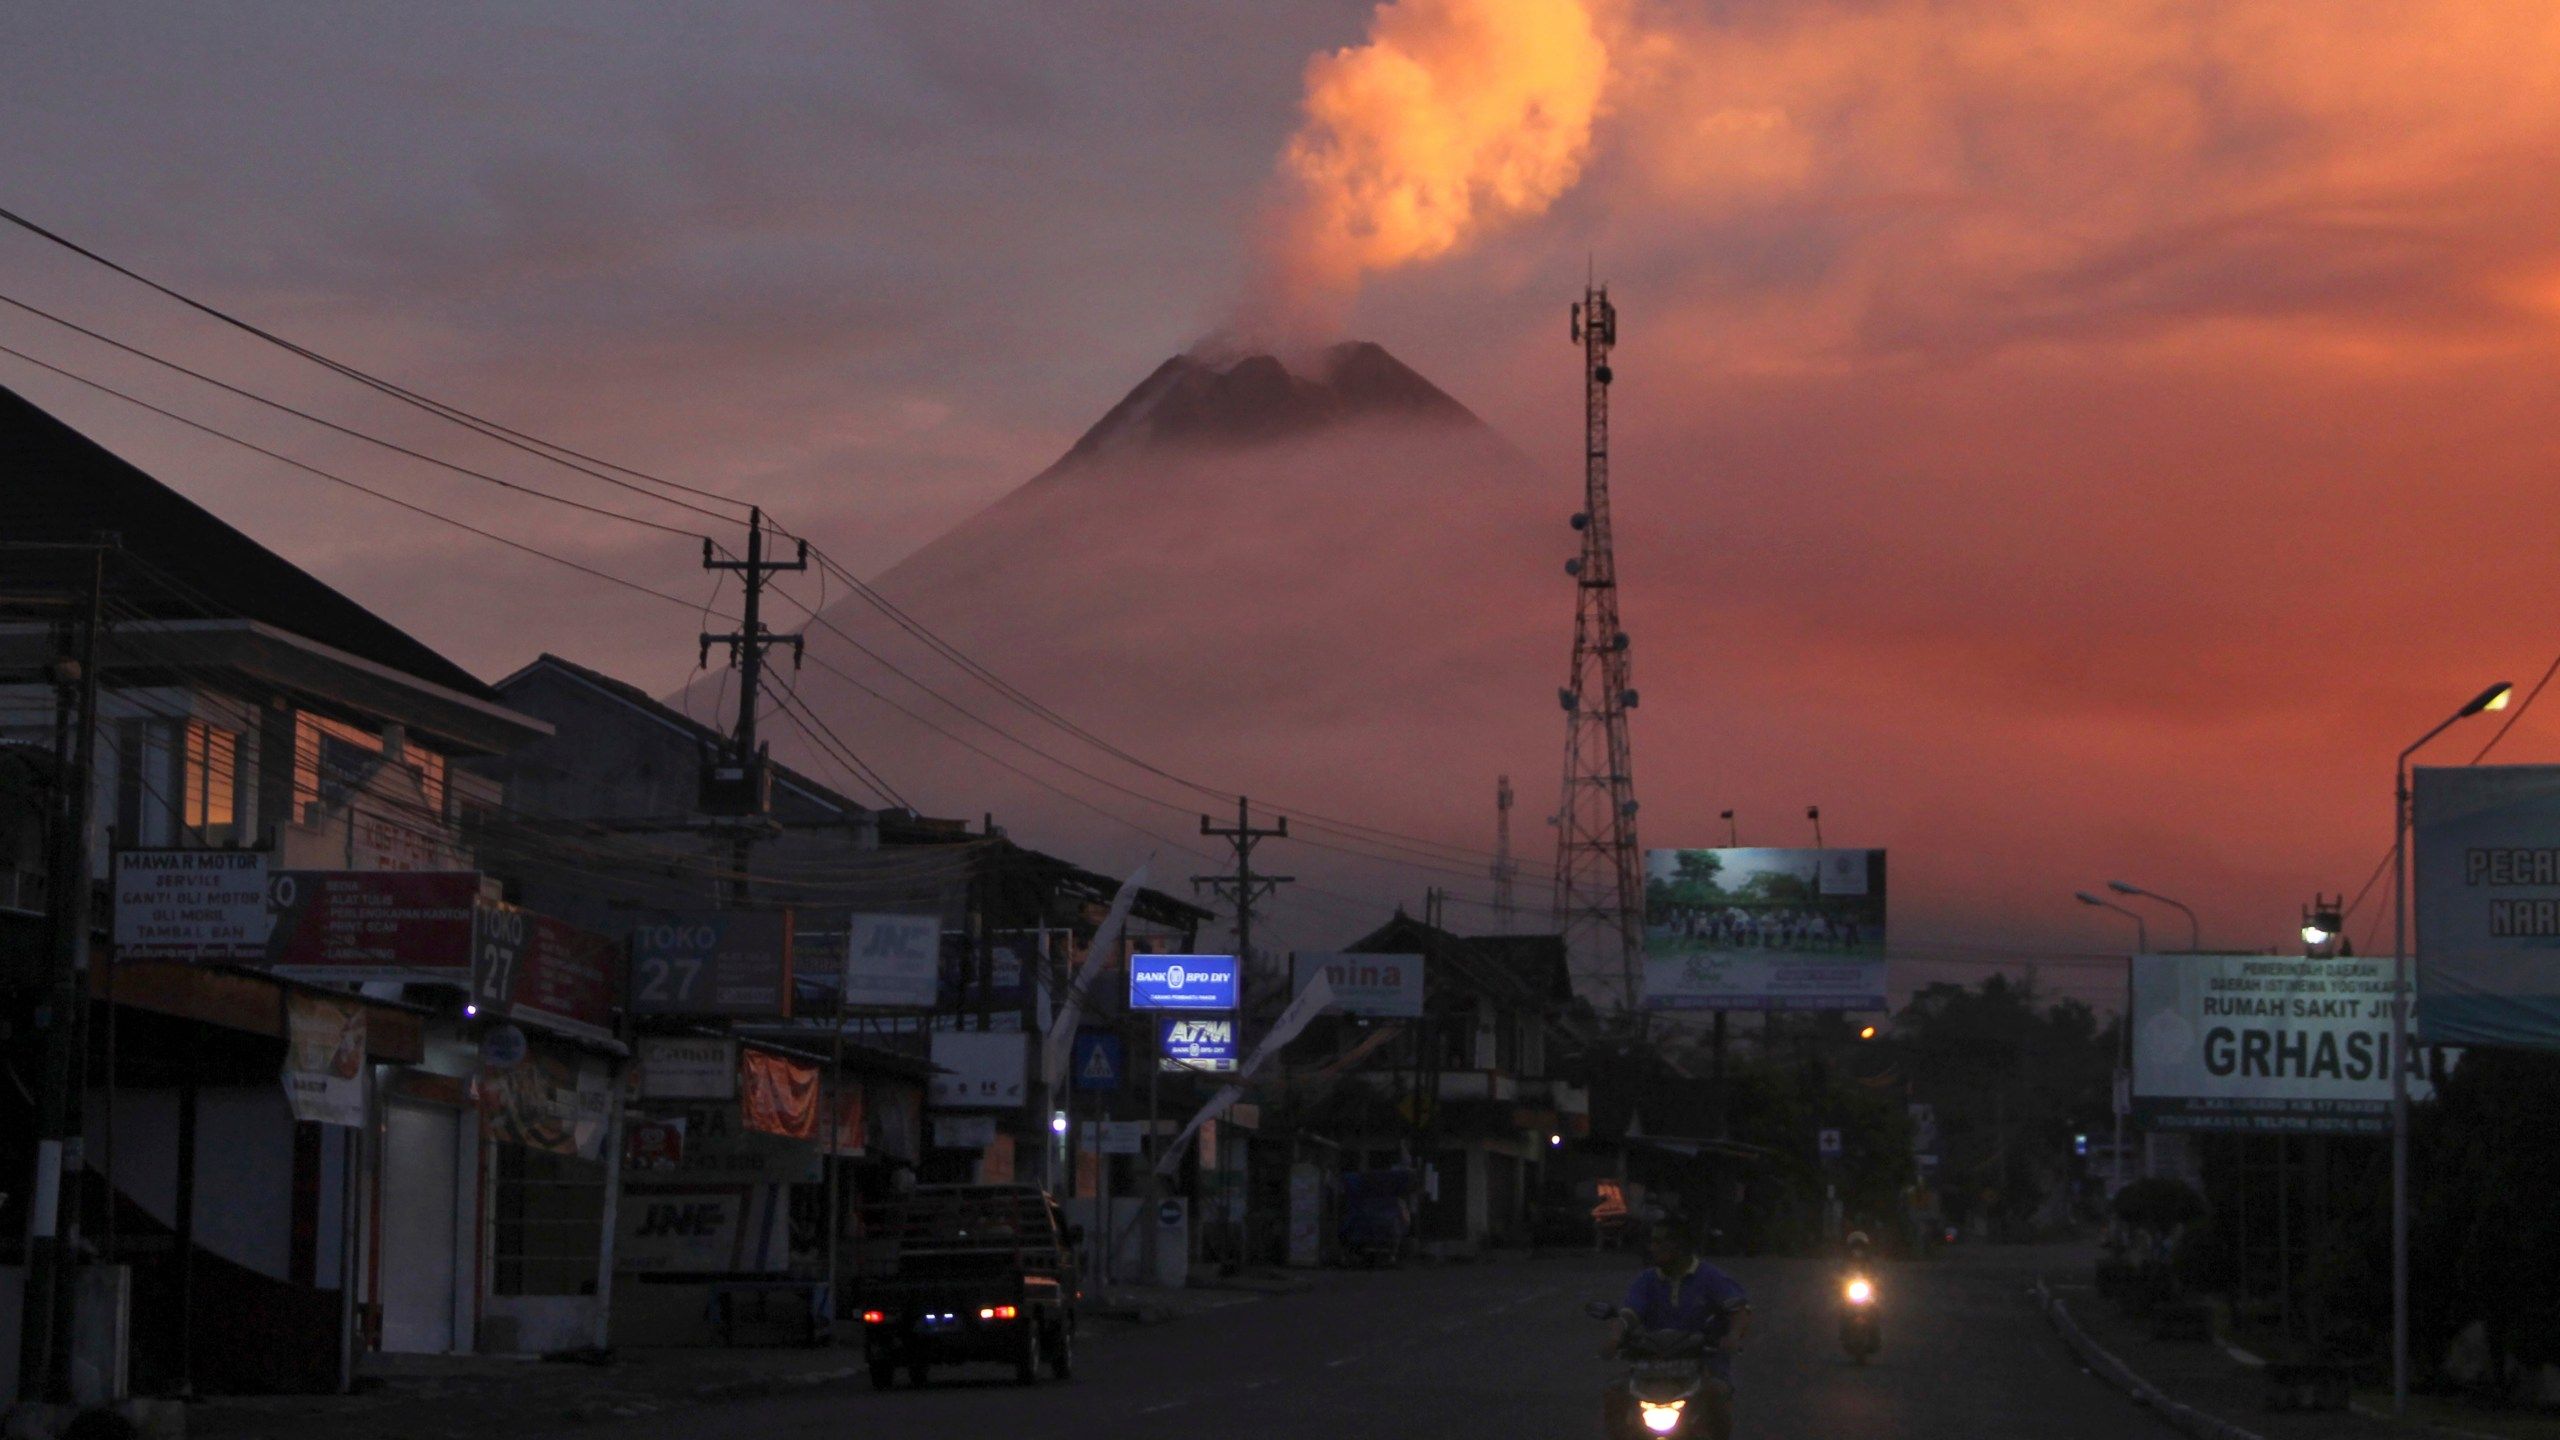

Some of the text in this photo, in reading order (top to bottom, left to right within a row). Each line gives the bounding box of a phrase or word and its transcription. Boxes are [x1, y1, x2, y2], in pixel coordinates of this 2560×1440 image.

[124, 854, 257, 870] MAWAR MOTOR
[2466, 848, 2560, 886] PECA
[207, 892, 260, 905] MOTOR
[483, 905, 523, 946] TOKO
[2489, 899, 2560, 937] NAR
[211, 926, 244, 939] BAN
[636, 925, 717, 949] TOKO
[482, 944, 513, 1002] 27
[638, 957, 703, 1001] 27
[1136, 972, 1231, 983] BANK BPD DIY
[2326, 963, 2379, 976] DAERAH
[2210, 978, 2261, 991] DAERAH
[2203, 996, 2286, 1017] RUMAH
[2293, 998, 2360, 1019] SAKIT
[1168, 1020, 1231, 1043] ATM
[2204, 1026, 2425, 1081] GRHASIA
[635, 1202, 726, 1237] JNE
